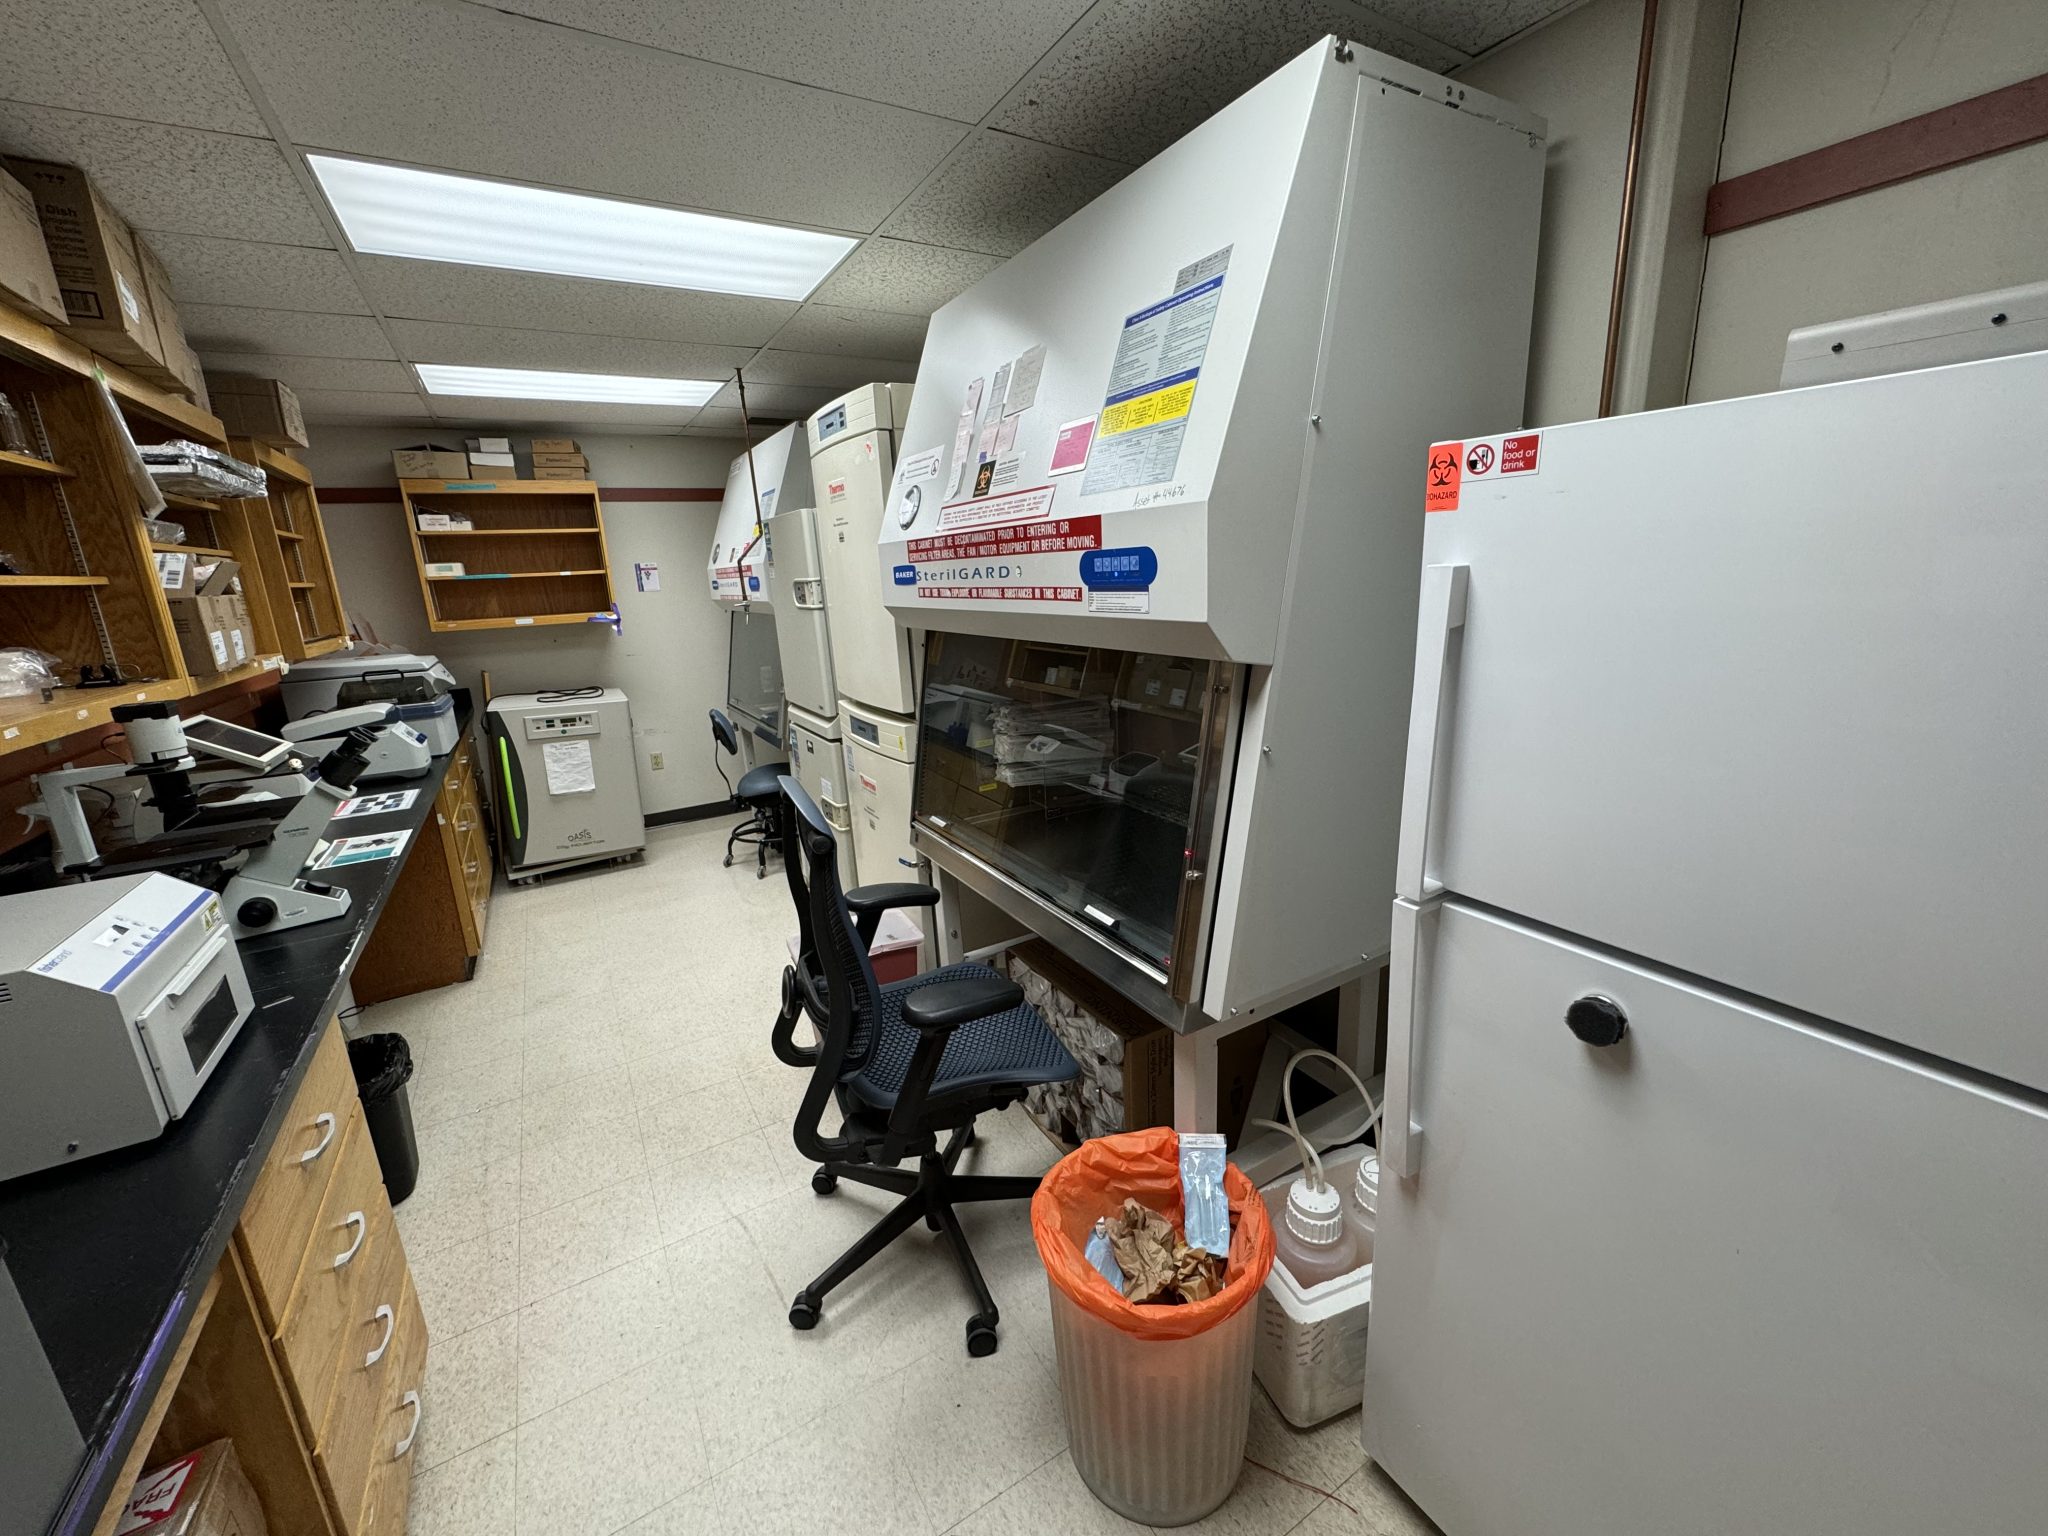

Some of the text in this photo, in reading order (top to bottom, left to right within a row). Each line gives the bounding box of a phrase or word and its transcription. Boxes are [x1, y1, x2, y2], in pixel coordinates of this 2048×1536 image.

[1504, 440, 1518, 450] No
[1503, 448, 1537, 460] food or
[1502, 460, 1525, 470] drink
[1427, 490, 1458, 501] OHAZARD
[908, 521, 1070, 551] THIS CABINET MUST BE DECONTAMINATED PRIOR TO ENTERING OR
[956, 547, 966, 558] THE
[999, 540, 1030, 554] EQUIPMENT
[1031, 539, 1041, 552] OR
[1041, 537, 1066, 551] BEFORE
[1066, 534, 1098, 549] MOVING.
[895, 571, 914, 579] BAKER
[916, 565, 1011, 582] SterilGARD
[978, 588, 1003, 599] FLAMMABLE
[1003, 588, 1033, 599] SUBSTANCES
[1034, 588, 1041, 599] IN
[1042, 588, 1055, 599] THIS
[567, 828, 593, 842] OASIS
